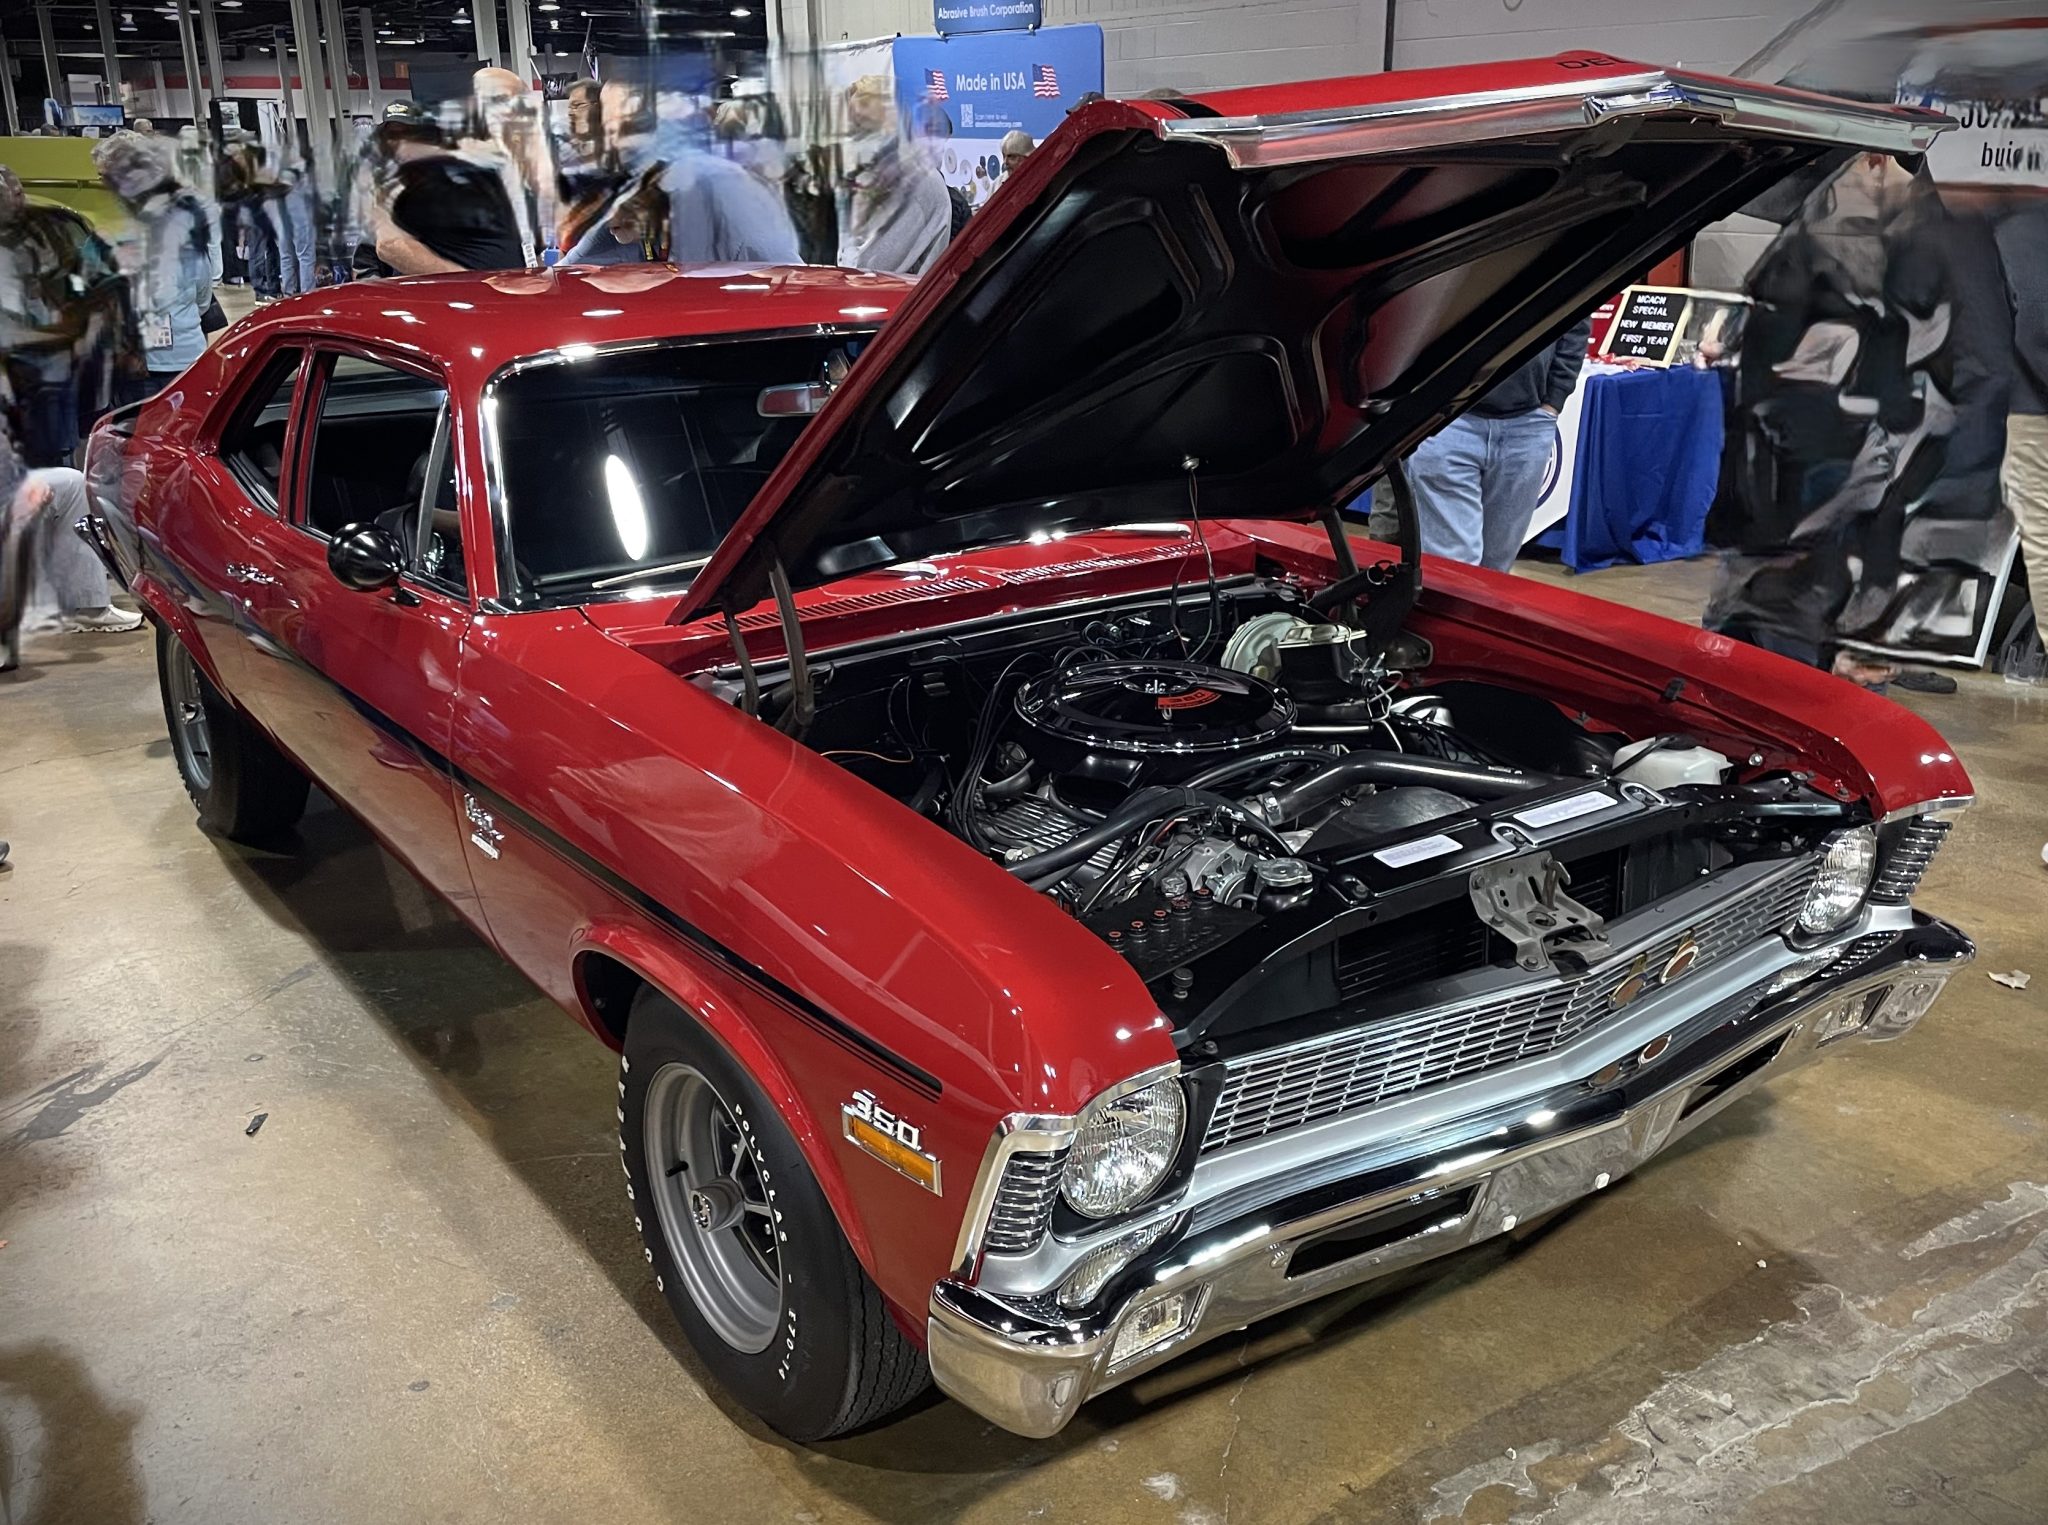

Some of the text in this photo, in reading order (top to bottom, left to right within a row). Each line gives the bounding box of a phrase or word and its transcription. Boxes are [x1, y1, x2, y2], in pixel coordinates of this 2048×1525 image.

[938, 2, 1035, 19] Abrasive Brush Corporation
[956, 72, 1026, 91] Made in USA
[1637, 295, 1666, 304] MCACN
[1632, 306, 1668, 316] SPECIAL
[1620, 320, 1674, 331] NEW MEMBER
[1620, 334, 1669, 345] FIRST YEAR
[1631, 345, 1647, 355] $40
[852, 1089, 921, 1151] 350
